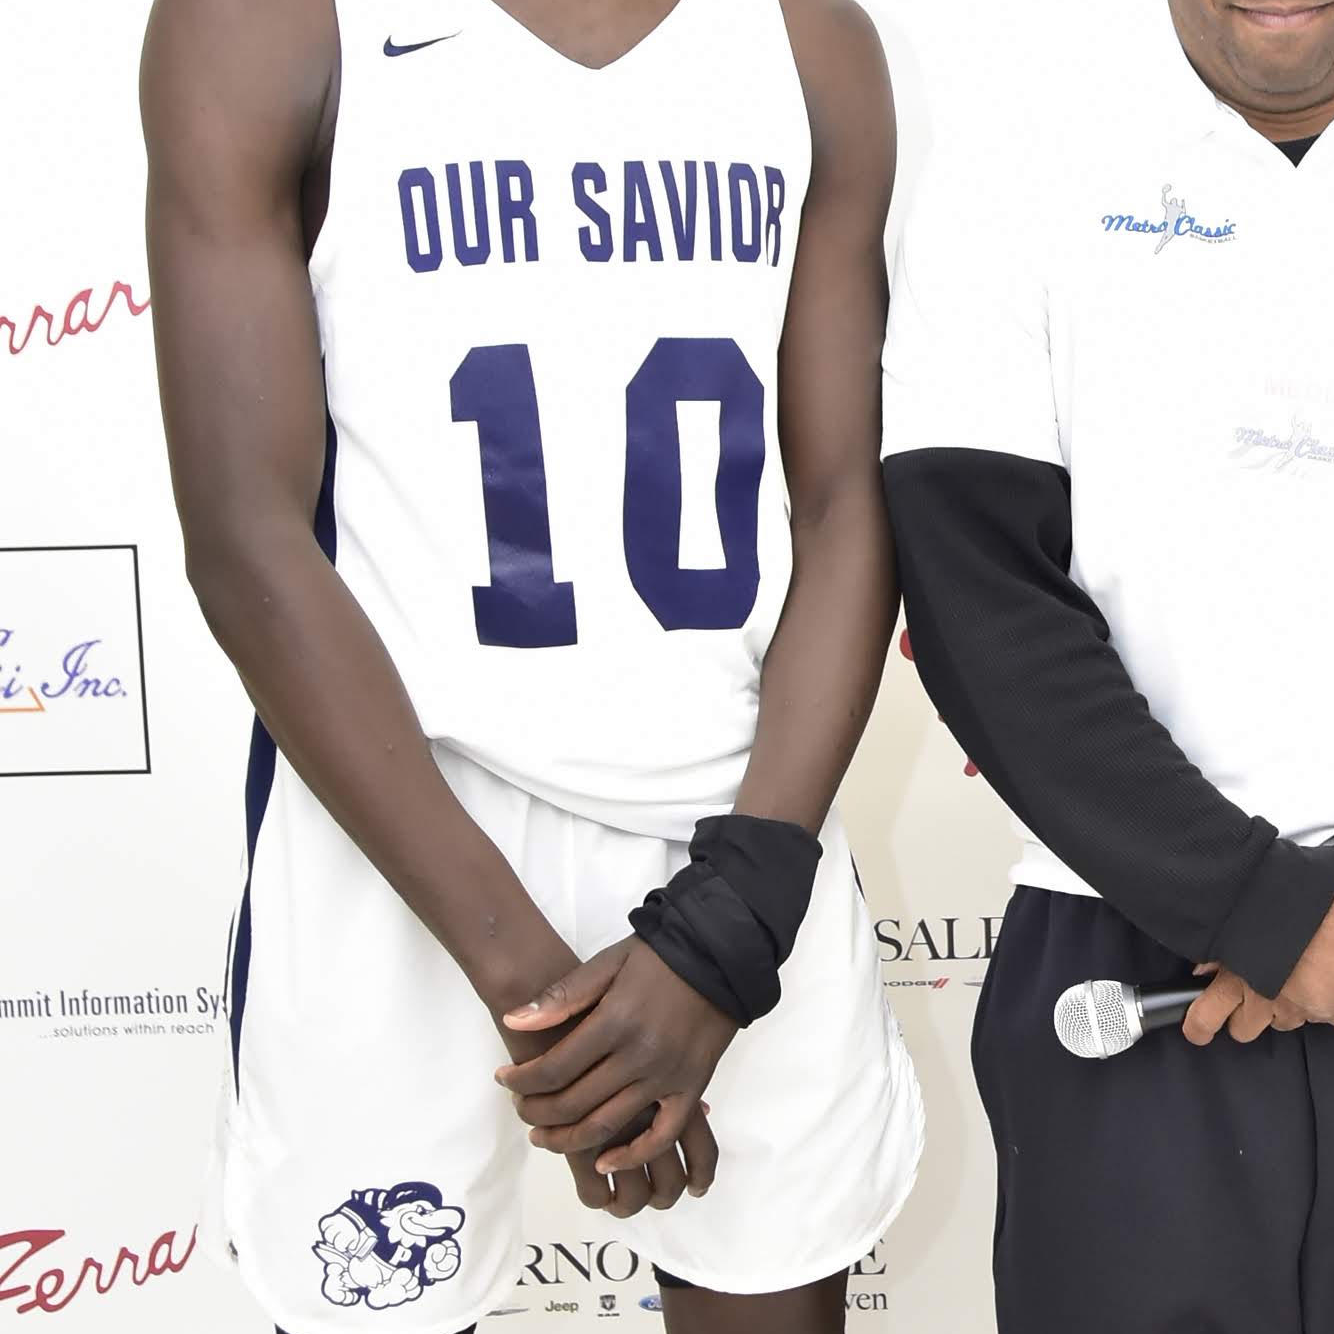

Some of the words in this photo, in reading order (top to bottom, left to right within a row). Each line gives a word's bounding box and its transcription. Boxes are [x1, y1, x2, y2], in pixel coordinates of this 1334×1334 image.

[398, 159, 540, 274] OUR
[570, 159, 786, 268] SAVIOR
[1101, 214, 1169, 234] Metro
[1174, 214, 1237, 238] Classic
[449, 336, 766, 649] 10
[41, 638, 127, 698] Inc.
[60, 988, 189, 1017] Information
[123, 1021, 167, 1037] within
[171, 1020, 215, 1035] reach
[545, 1299, 580, 1314] Jeep
